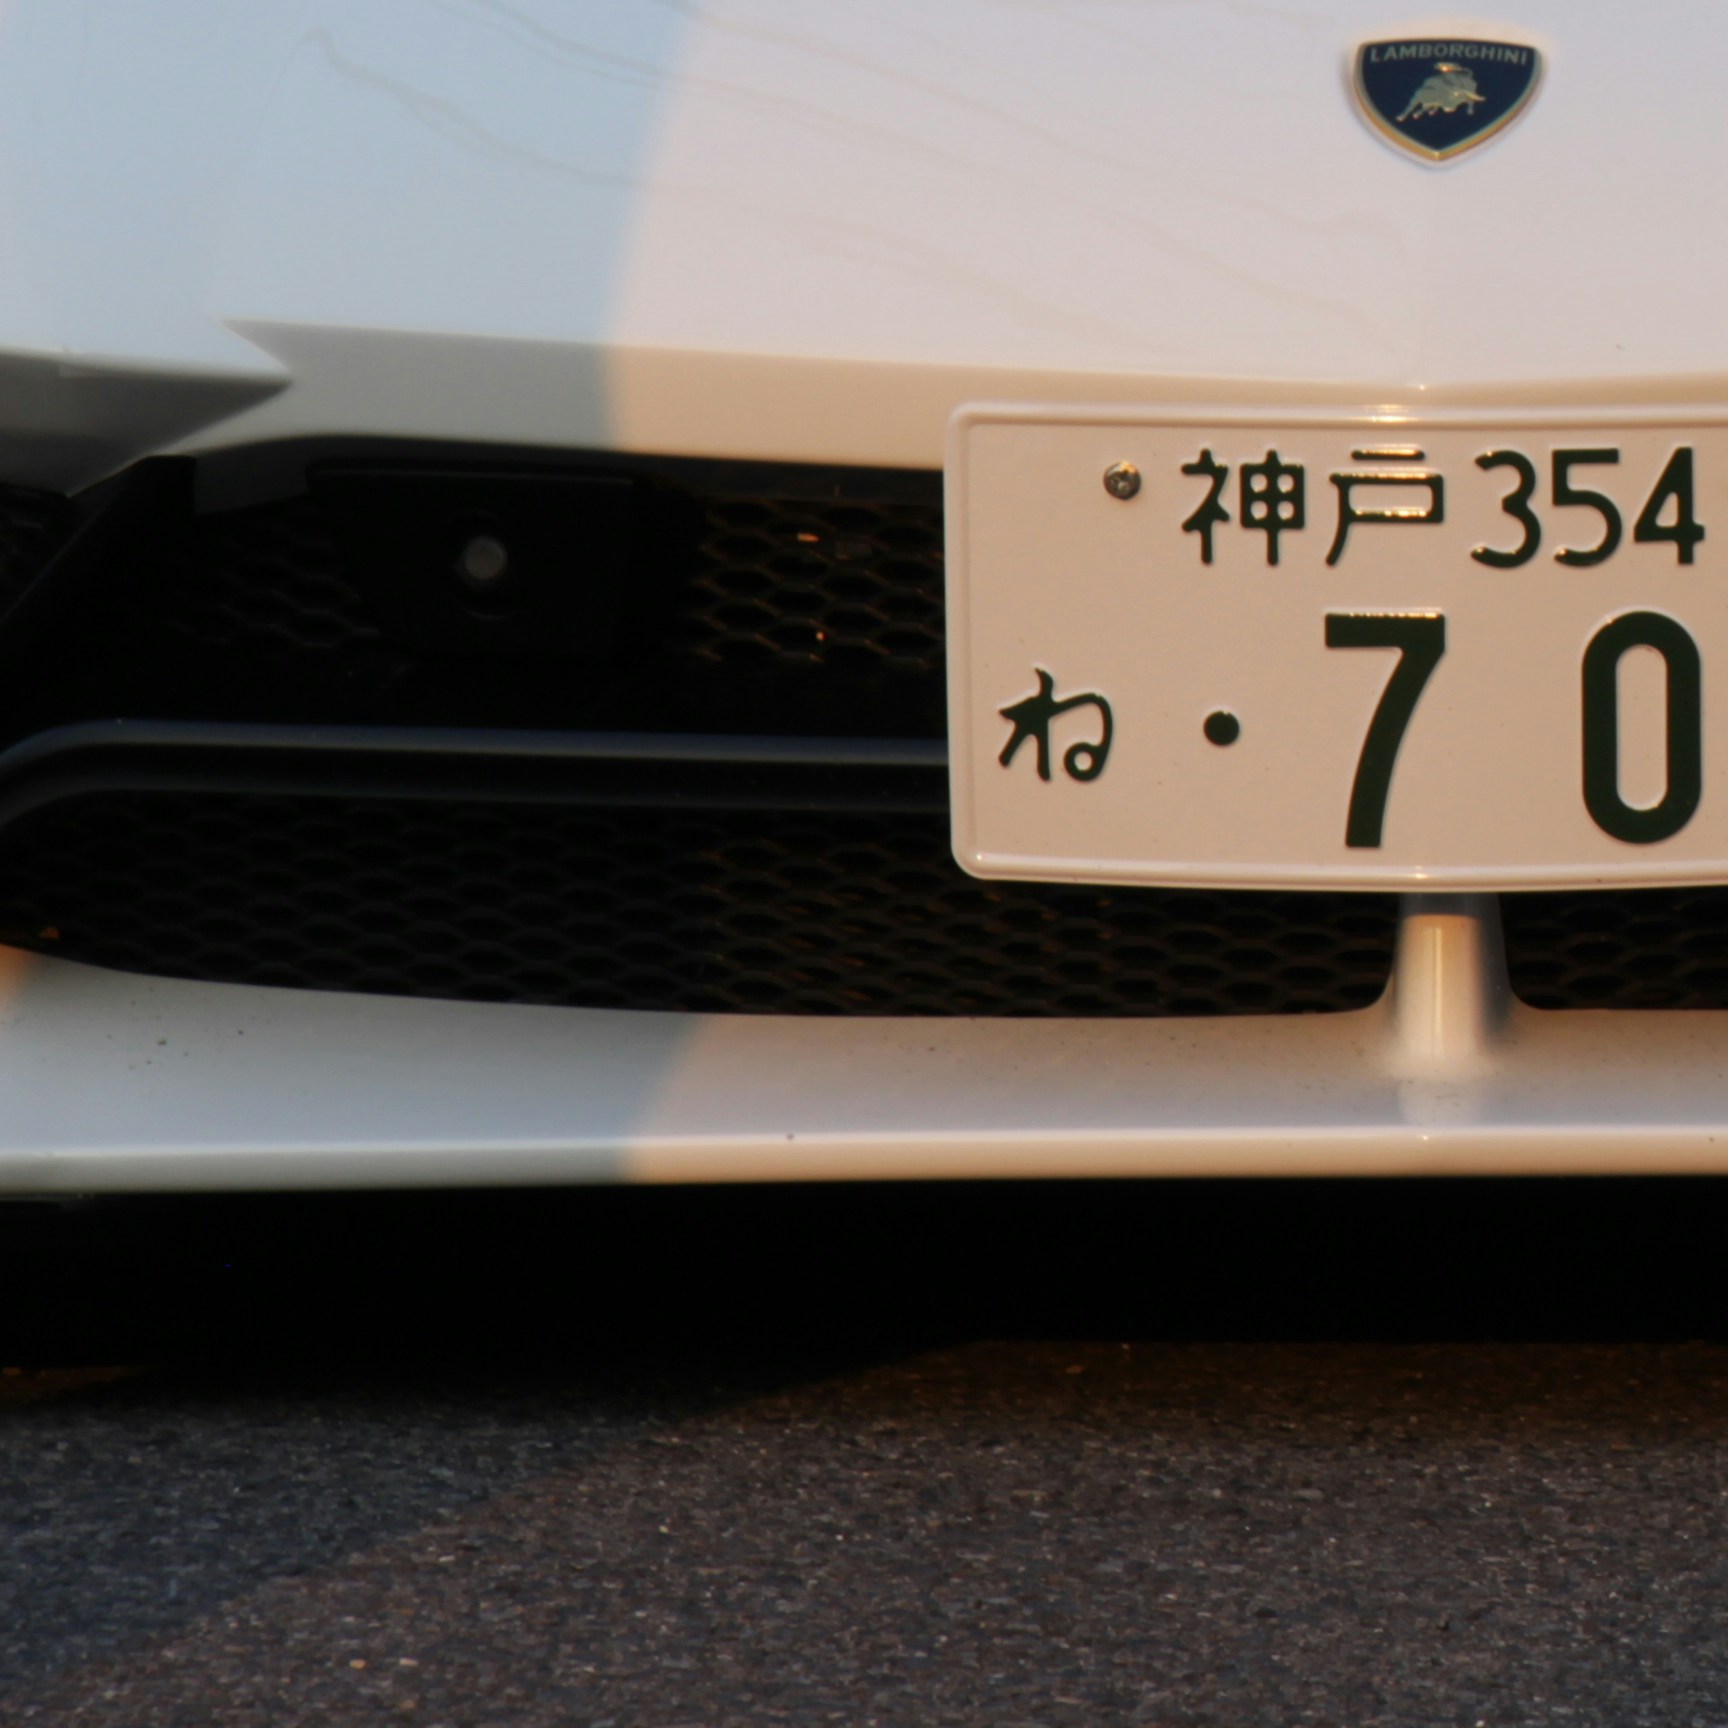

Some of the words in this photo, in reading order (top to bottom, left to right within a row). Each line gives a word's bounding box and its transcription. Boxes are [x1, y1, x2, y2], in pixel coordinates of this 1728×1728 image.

[1370, 43, 1528, 66] LAMBORGHINI
[1471, 447, 1706, 569] 354
[998, 669, 1113, 783] ね
